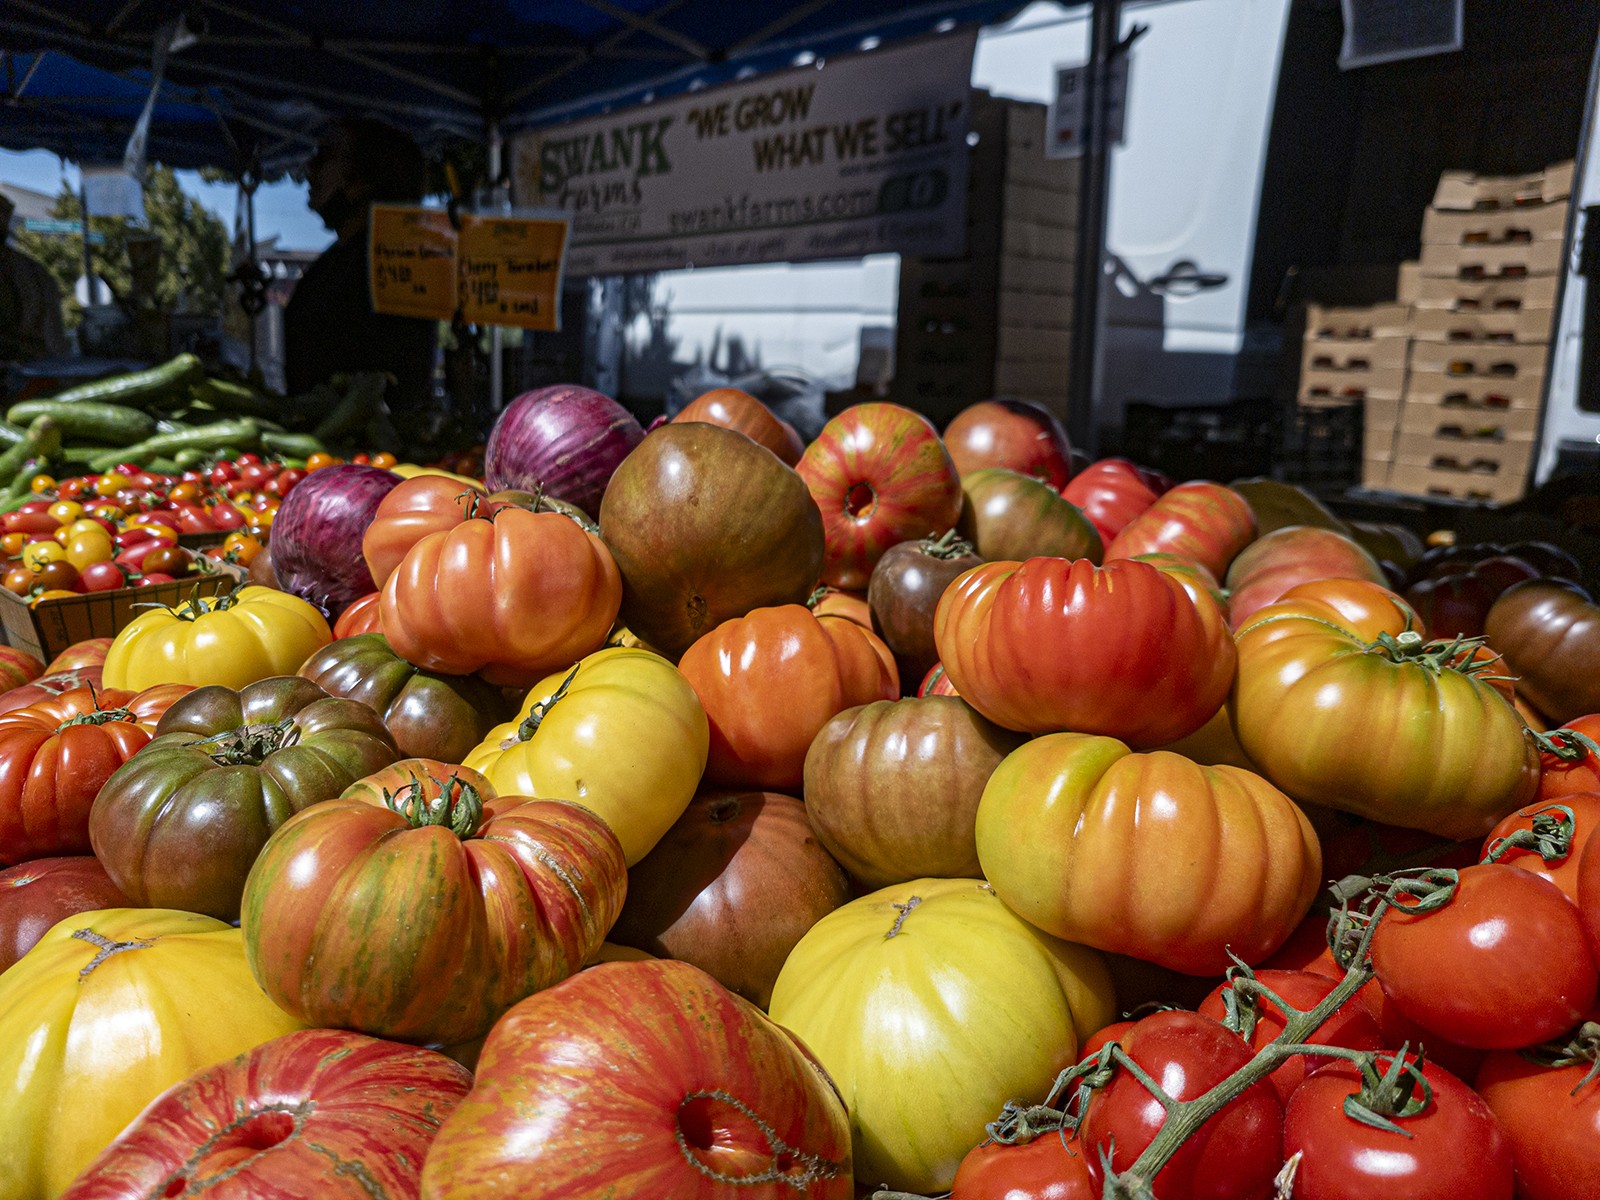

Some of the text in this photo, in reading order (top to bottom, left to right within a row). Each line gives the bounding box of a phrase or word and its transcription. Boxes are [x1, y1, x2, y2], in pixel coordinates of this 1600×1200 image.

[735, 85, 815, 132] GROW
[753, 127, 829, 173] WHAT
[834, 116, 877, 161] WE
[885, 102, 962, 152] SELL"
[540, 117, 673, 194] SWANK
